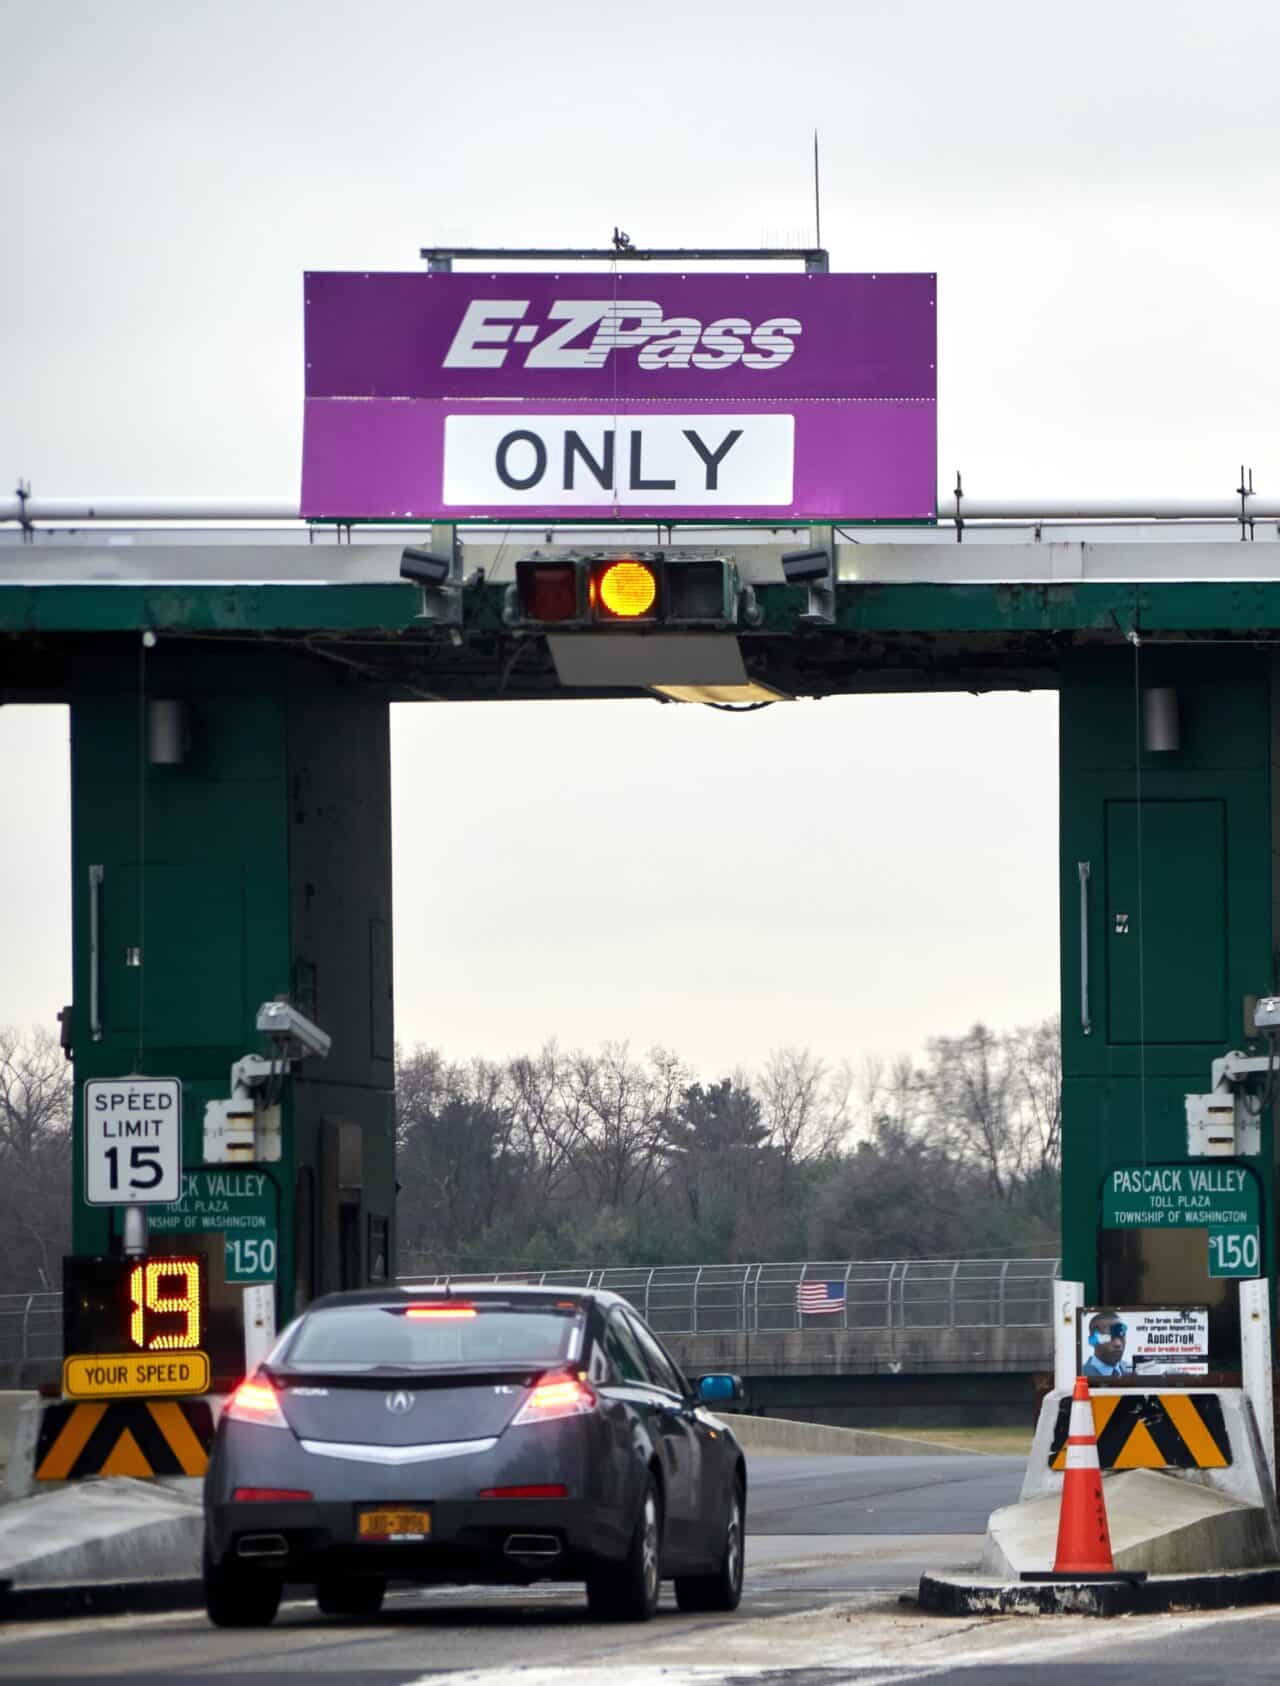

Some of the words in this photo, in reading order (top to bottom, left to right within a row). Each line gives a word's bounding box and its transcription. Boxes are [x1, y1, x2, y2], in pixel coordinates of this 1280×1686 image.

[442, 299, 802, 370] E-ZPass
[494, 430, 744, 491] ONLY
[95, 1093, 173, 1111] SPEED
[103, 1120, 164, 1138] LIMIT
[104, 1146, 164, 1190] 15
[207, 1175, 266, 1197] VALLEY
[1113, 1170, 1182, 1193] PASCACK
[1189, 1169, 1247, 1192] VALLEY
[195, 1200, 230, 1212] PLAZA
[1150, 1195, 1173, 1208] TOLL
[1178, 1195, 1211, 1208] PLAZA
[148, 1216, 181, 1228] NSHIP
[184, 1216, 198, 1228] OF
[201, 1216, 267, 1228] WASHINGTON
[1114, 1211, 1165, 1223] TOWNSHIP
[1168, 1211, 1181, 1223] OF
[1185, 1210, 1248, 1223] WASHINGTON
[131, 1261, 200, 1349] 19
[84, 1366, 128, 1385] YOUR
[136, 1364, 190, 1383] SPEED
